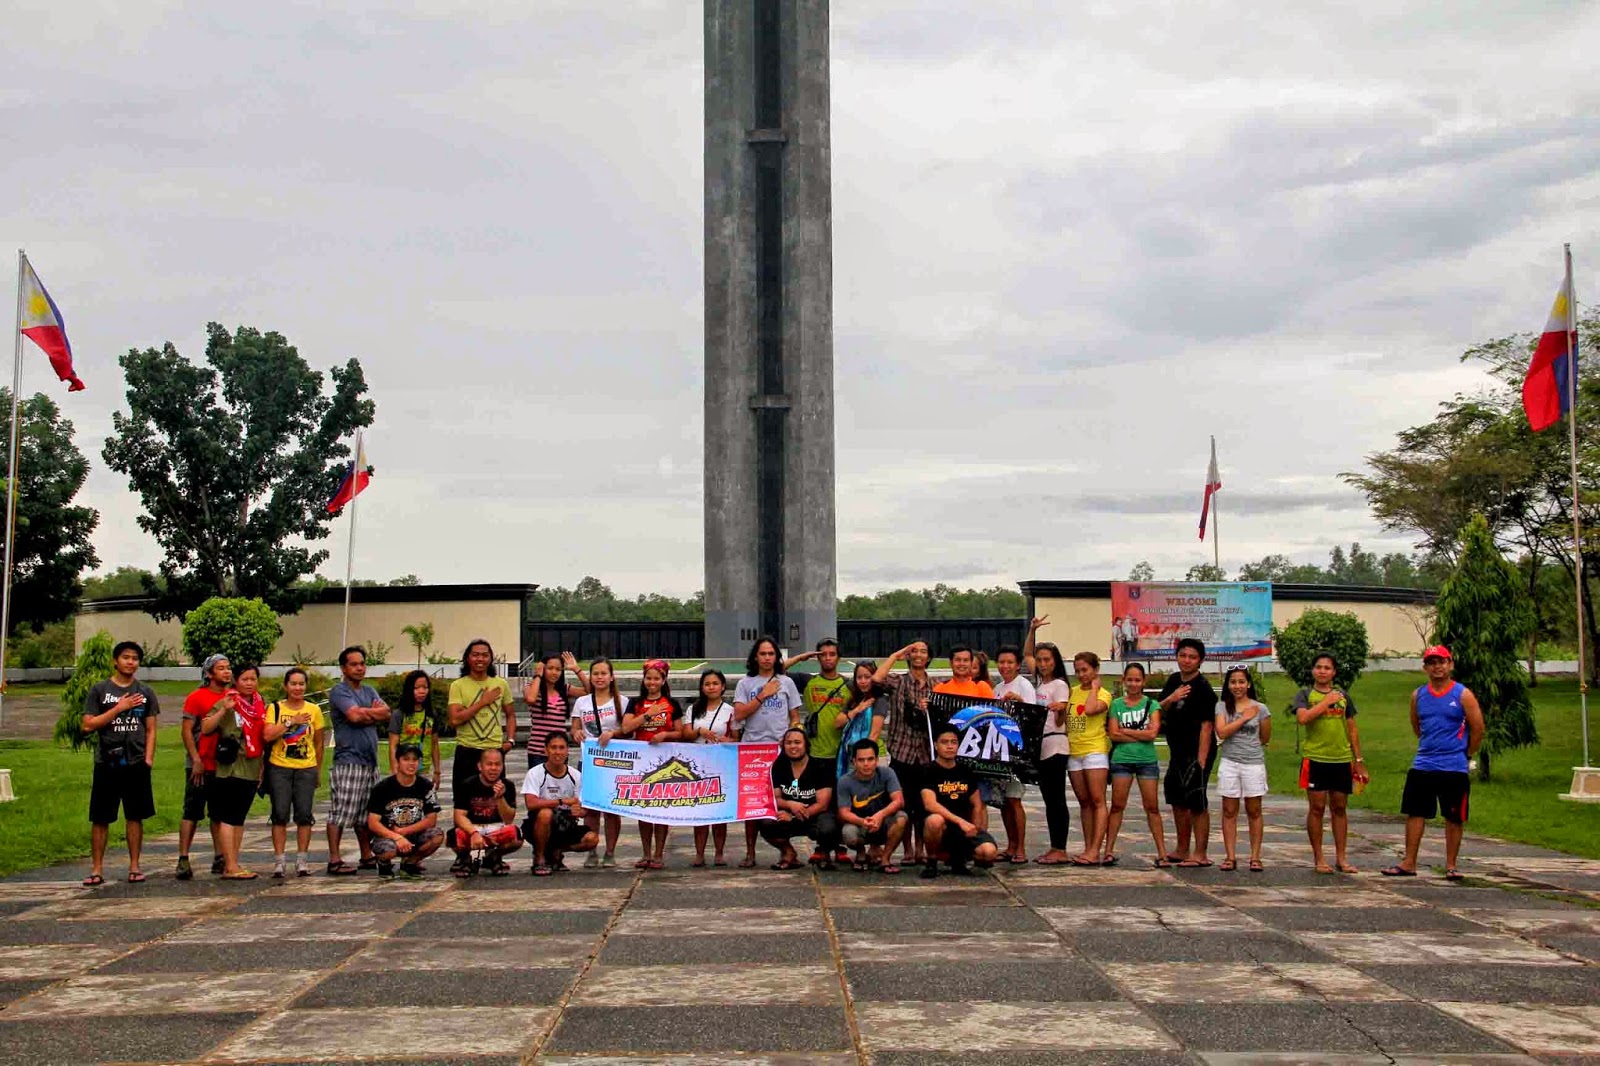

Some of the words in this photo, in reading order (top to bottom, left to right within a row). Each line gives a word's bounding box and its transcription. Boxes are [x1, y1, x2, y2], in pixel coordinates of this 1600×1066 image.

[1165, 598, 1217, 606] WELCOME
[588, 747, 615, 758] Hitting
[620, 750, 638, 760] Trail
[617, 778, 721, 800] TELAKAWA
[649, 799, 669, 808] 2014,
[671, 799, 696, 807] CAPAS,
[698, 796, 725, 805] TARLAC
